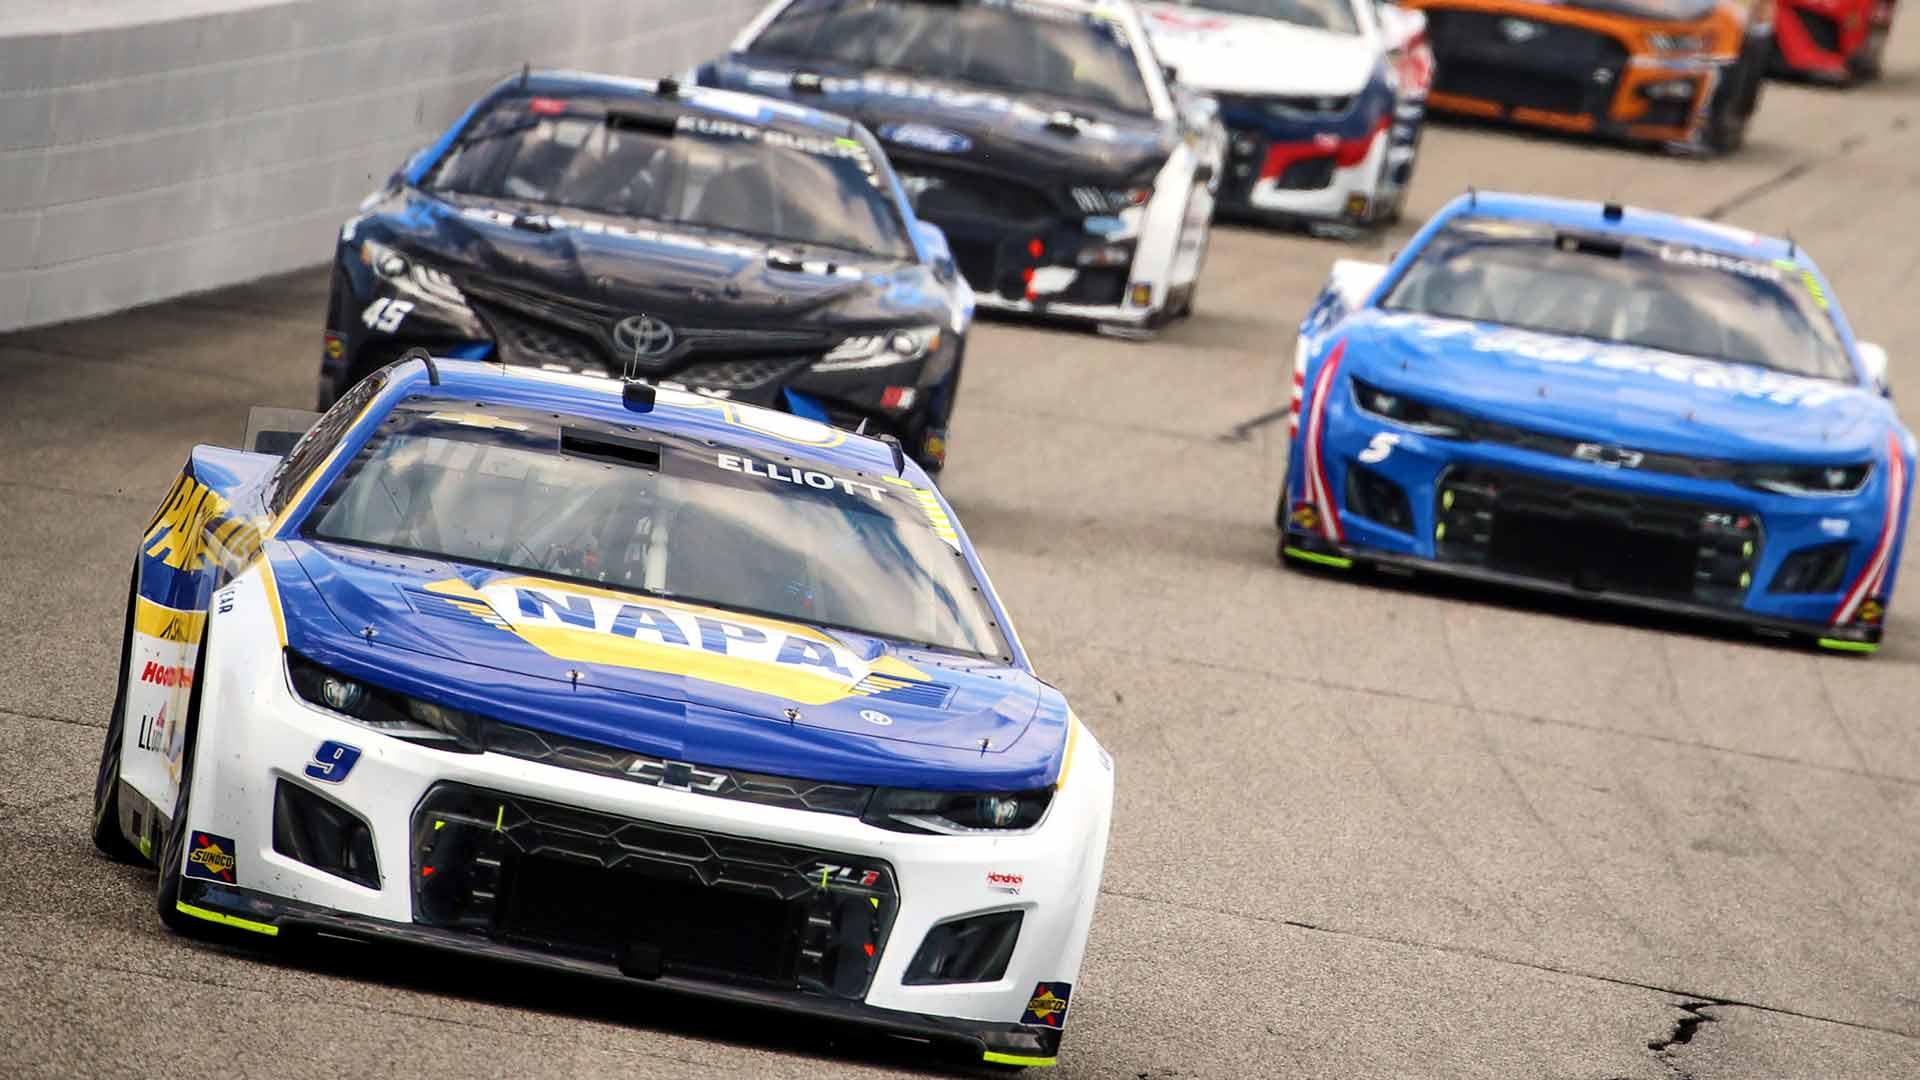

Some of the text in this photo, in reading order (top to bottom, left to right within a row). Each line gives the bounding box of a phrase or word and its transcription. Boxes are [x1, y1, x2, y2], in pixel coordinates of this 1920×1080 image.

[362, 297, 415, 333] 45
[1358, 431, 1400, 463] 5
[718, 452, 888, 502] ELLIOTT
[514, 588, 856, 679] NAPA
[304, 739, 362, 785] 9
[192, 849, 233, 869] SUNOCO
